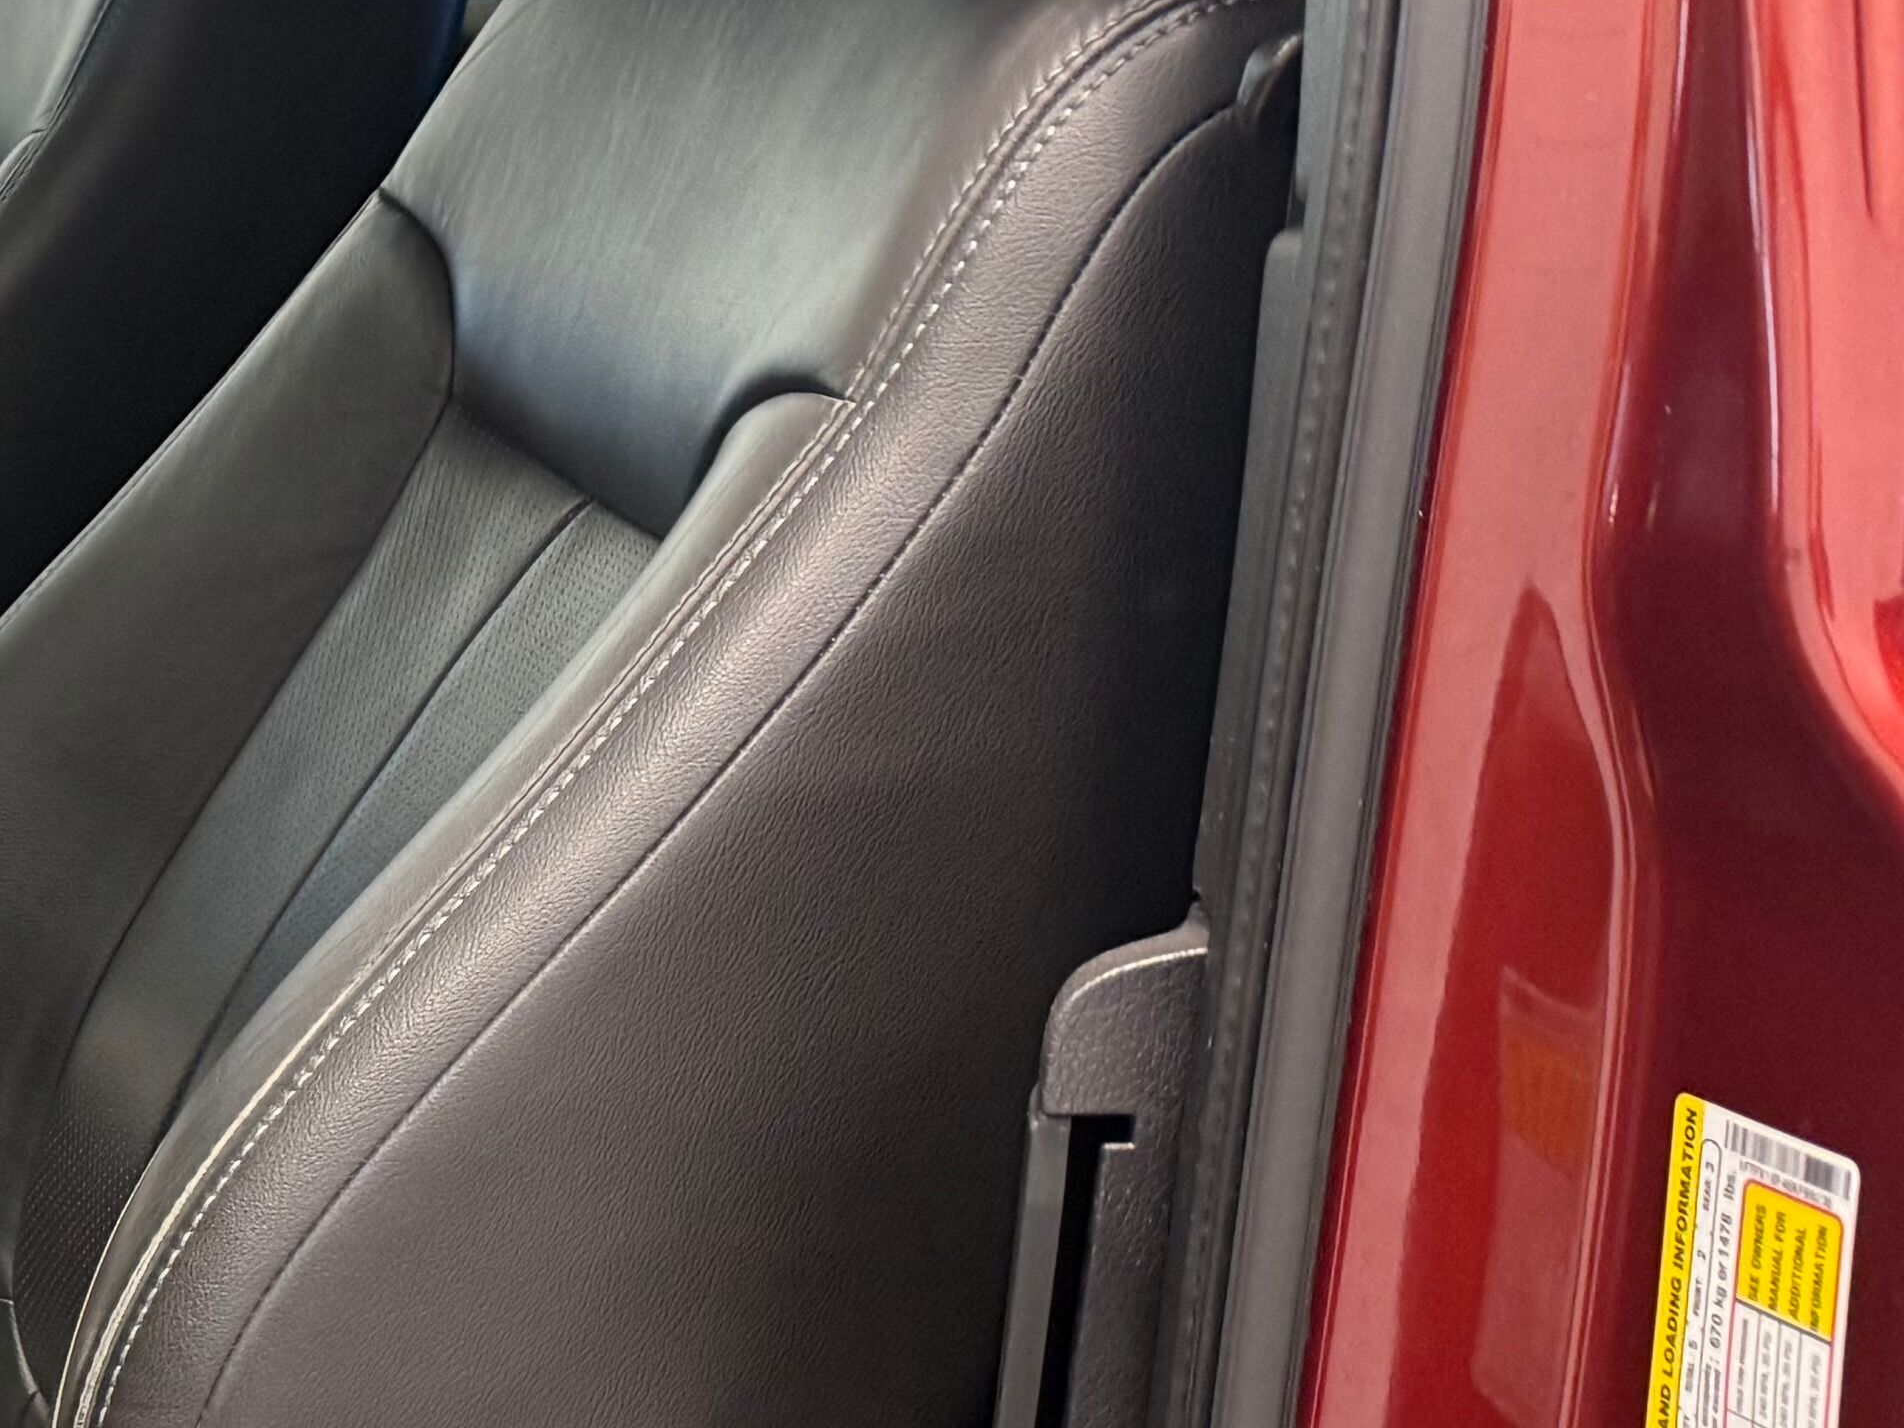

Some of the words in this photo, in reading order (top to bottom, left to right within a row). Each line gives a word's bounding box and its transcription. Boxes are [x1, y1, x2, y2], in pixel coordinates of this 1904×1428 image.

[1662, 1276, 1682, 1378] LOADING
[1672, 1108, 1697, 1270] INFORMATION
[1774, 1211, 1786, 1243] FOR
[1718, 1262, 1727, 1281] or
[1768, 1249, 1784, 1312] MANUAL
[1788, 1228, 1807, 1320] ADDITIONAL
[1810, 1224, 1828, 1332] INFORMATION
[1713, 1285, 1728, 1308] kg
[1709, 1314, 1722, 1348] 670
